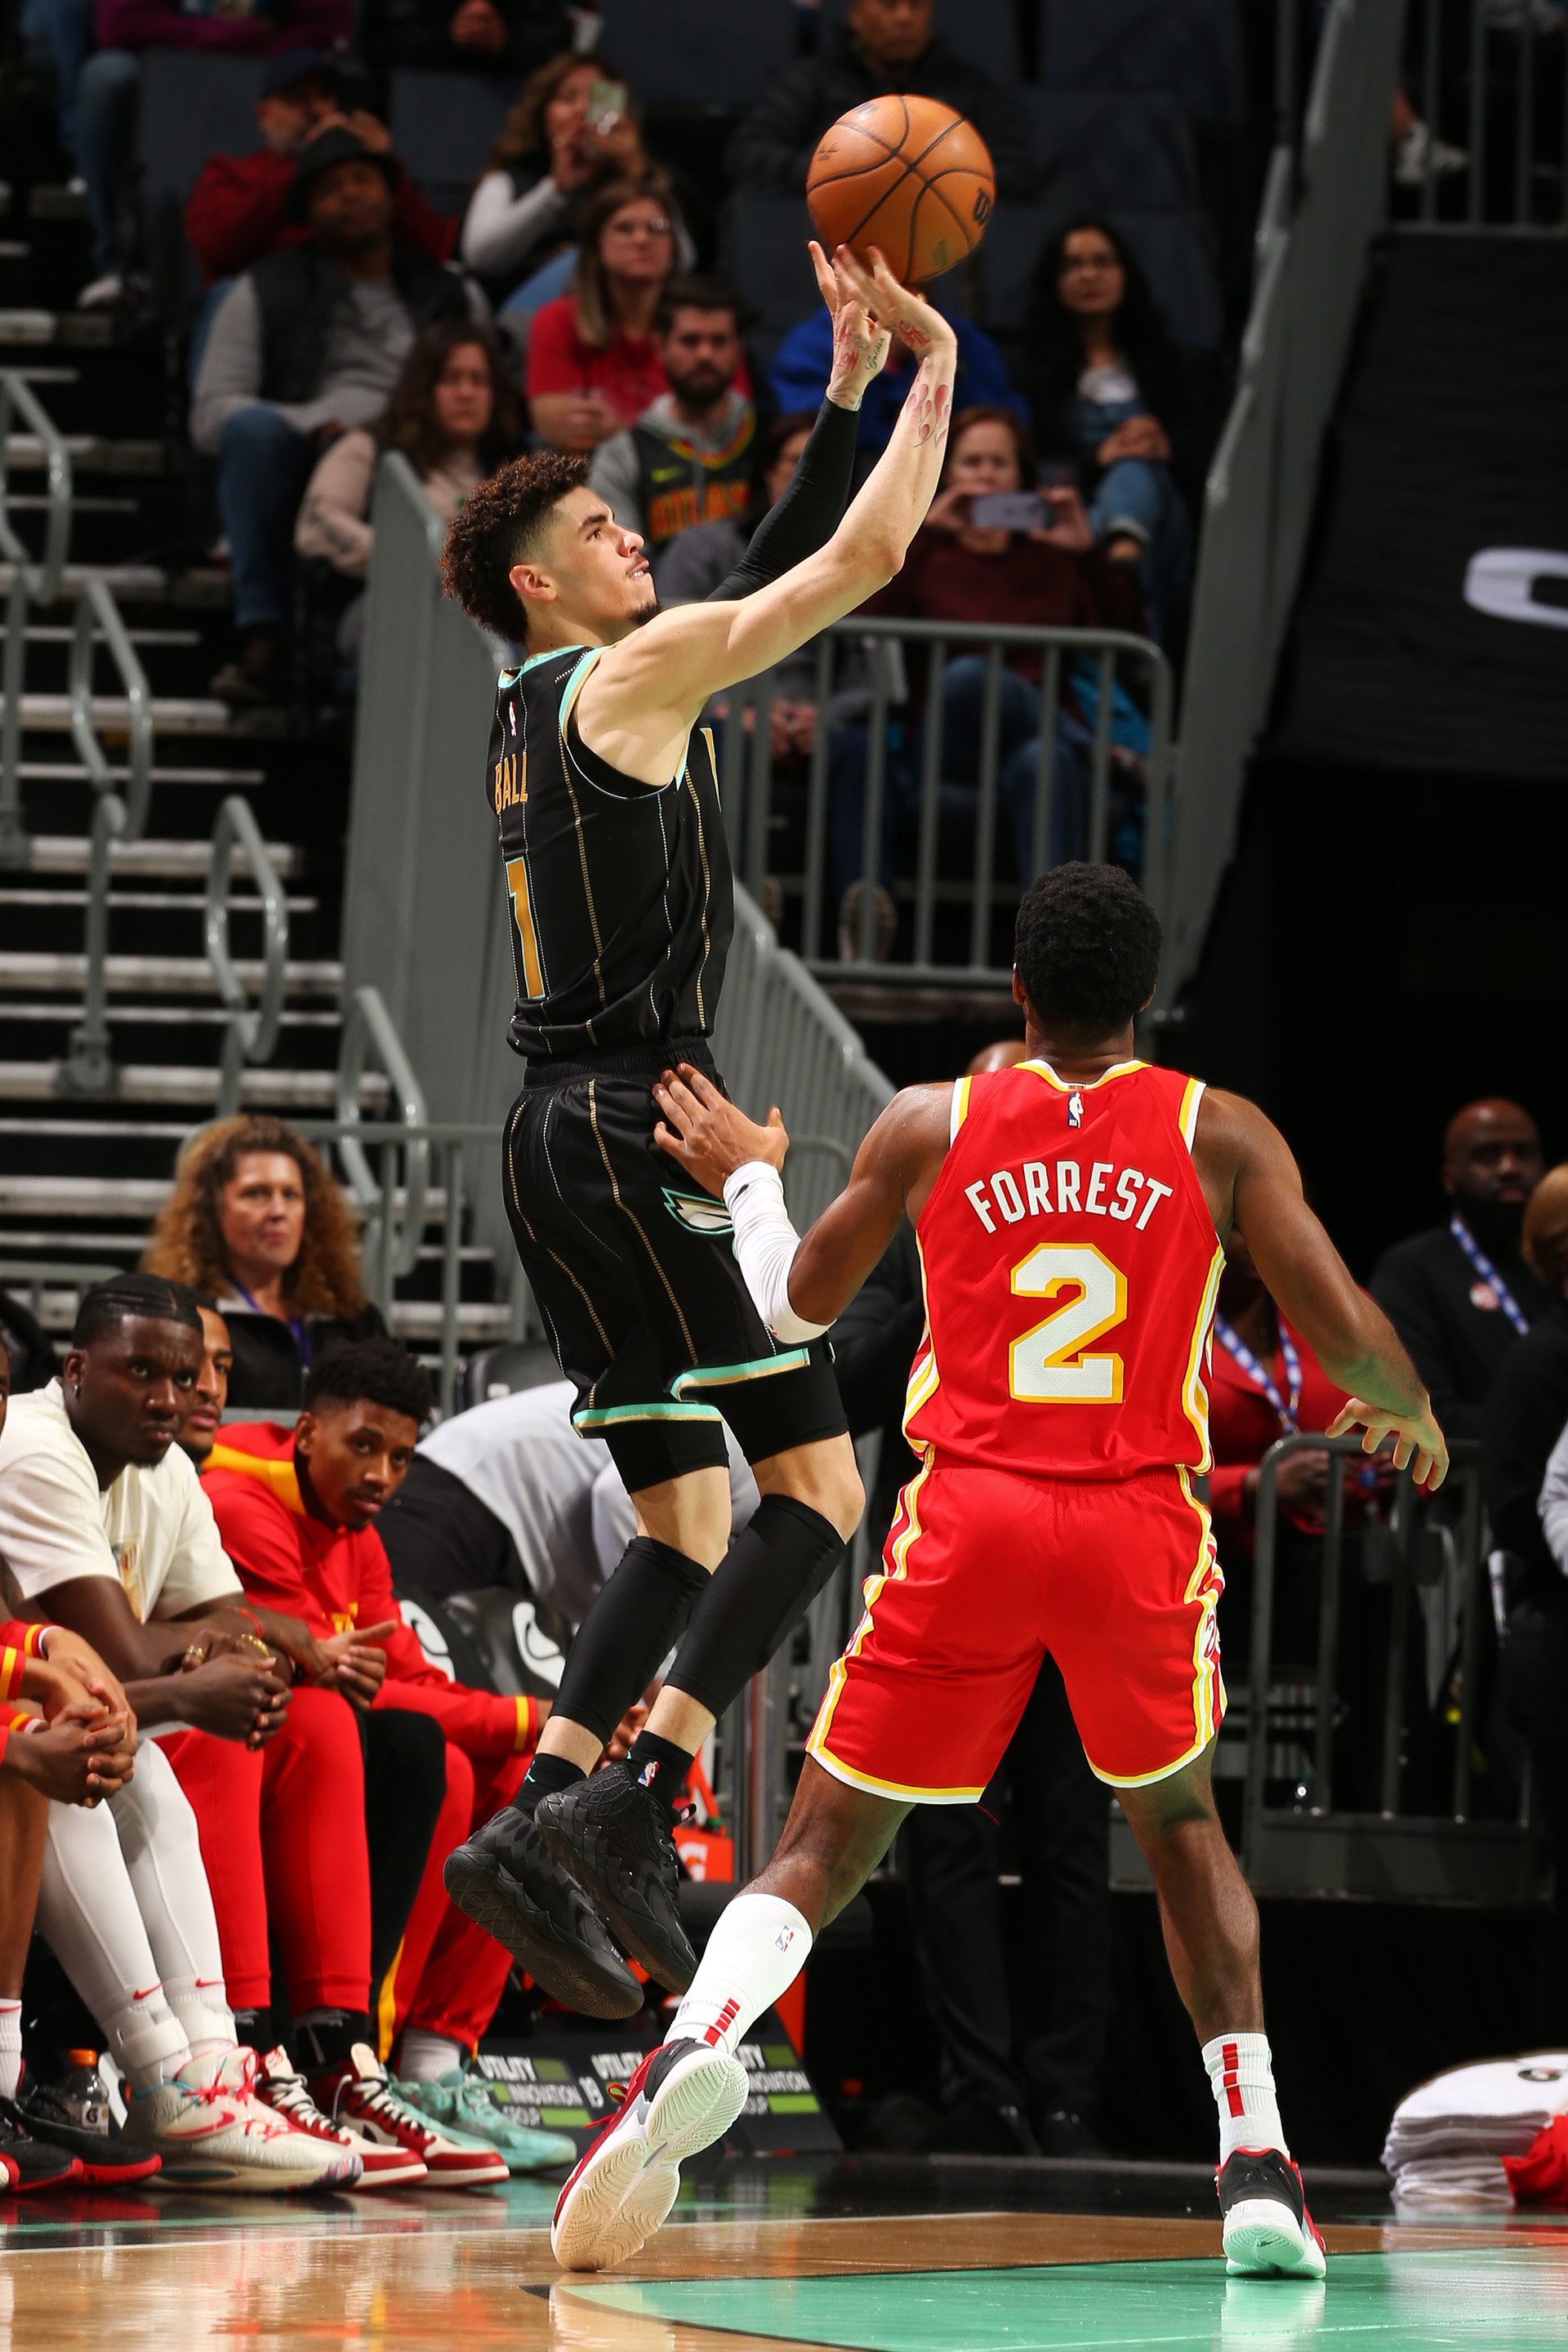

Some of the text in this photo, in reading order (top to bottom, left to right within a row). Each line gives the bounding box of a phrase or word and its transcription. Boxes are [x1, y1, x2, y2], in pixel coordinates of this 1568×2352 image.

[866, 336, 885, 370] Golden
[494, 751, 528, 815] BALL
[506, 855, 546, 1000] 1
[964, 1160, 1174, 1235] FORREST
[1009, 1241, 1128, 1405] 2
[477, 2054, 537, 2082] UTILITY
